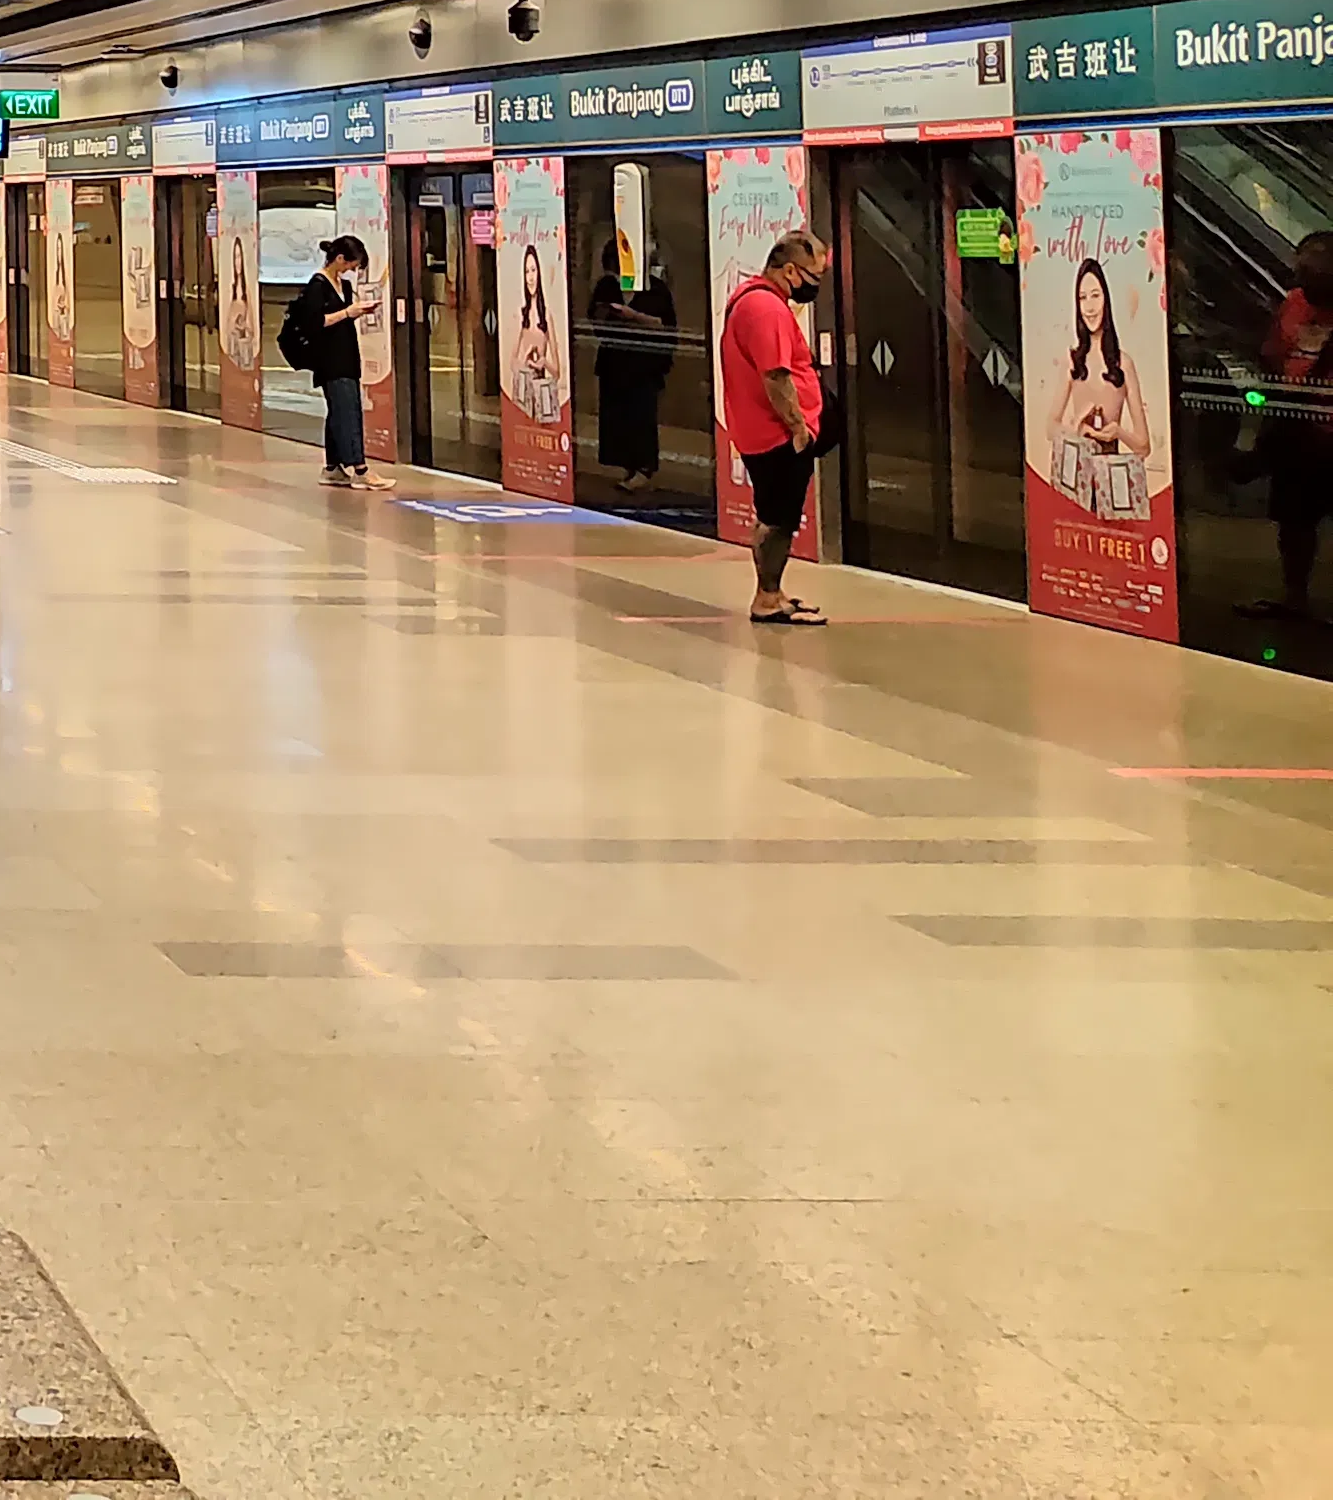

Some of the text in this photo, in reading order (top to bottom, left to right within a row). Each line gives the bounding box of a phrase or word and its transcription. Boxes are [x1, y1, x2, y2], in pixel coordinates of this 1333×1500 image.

[1175, 14, 1333, 66] Bukit Panja
[1027, 36, 1137, 82] 武吉班让
[14, 95, 53, 115] EXIT
[499, 94, 555, 122] 武吉班让
[570, 85, 606, 117] Bukit
[607, 83, 664, 118] Panjang
[733, 191, 779, 207] CELEBRATE
[1051, 203, 1124, 219] HANDPICKED
[1047, 215, 1089, 263] with
[1095, 213, 1133, 266] love
[1054, 528, 1079, 550] BUY
[1087, 534, 1092, 553] 1
[1099, 536, 1133, 560] FREE
[1139, 543, 1145, 564] 1
